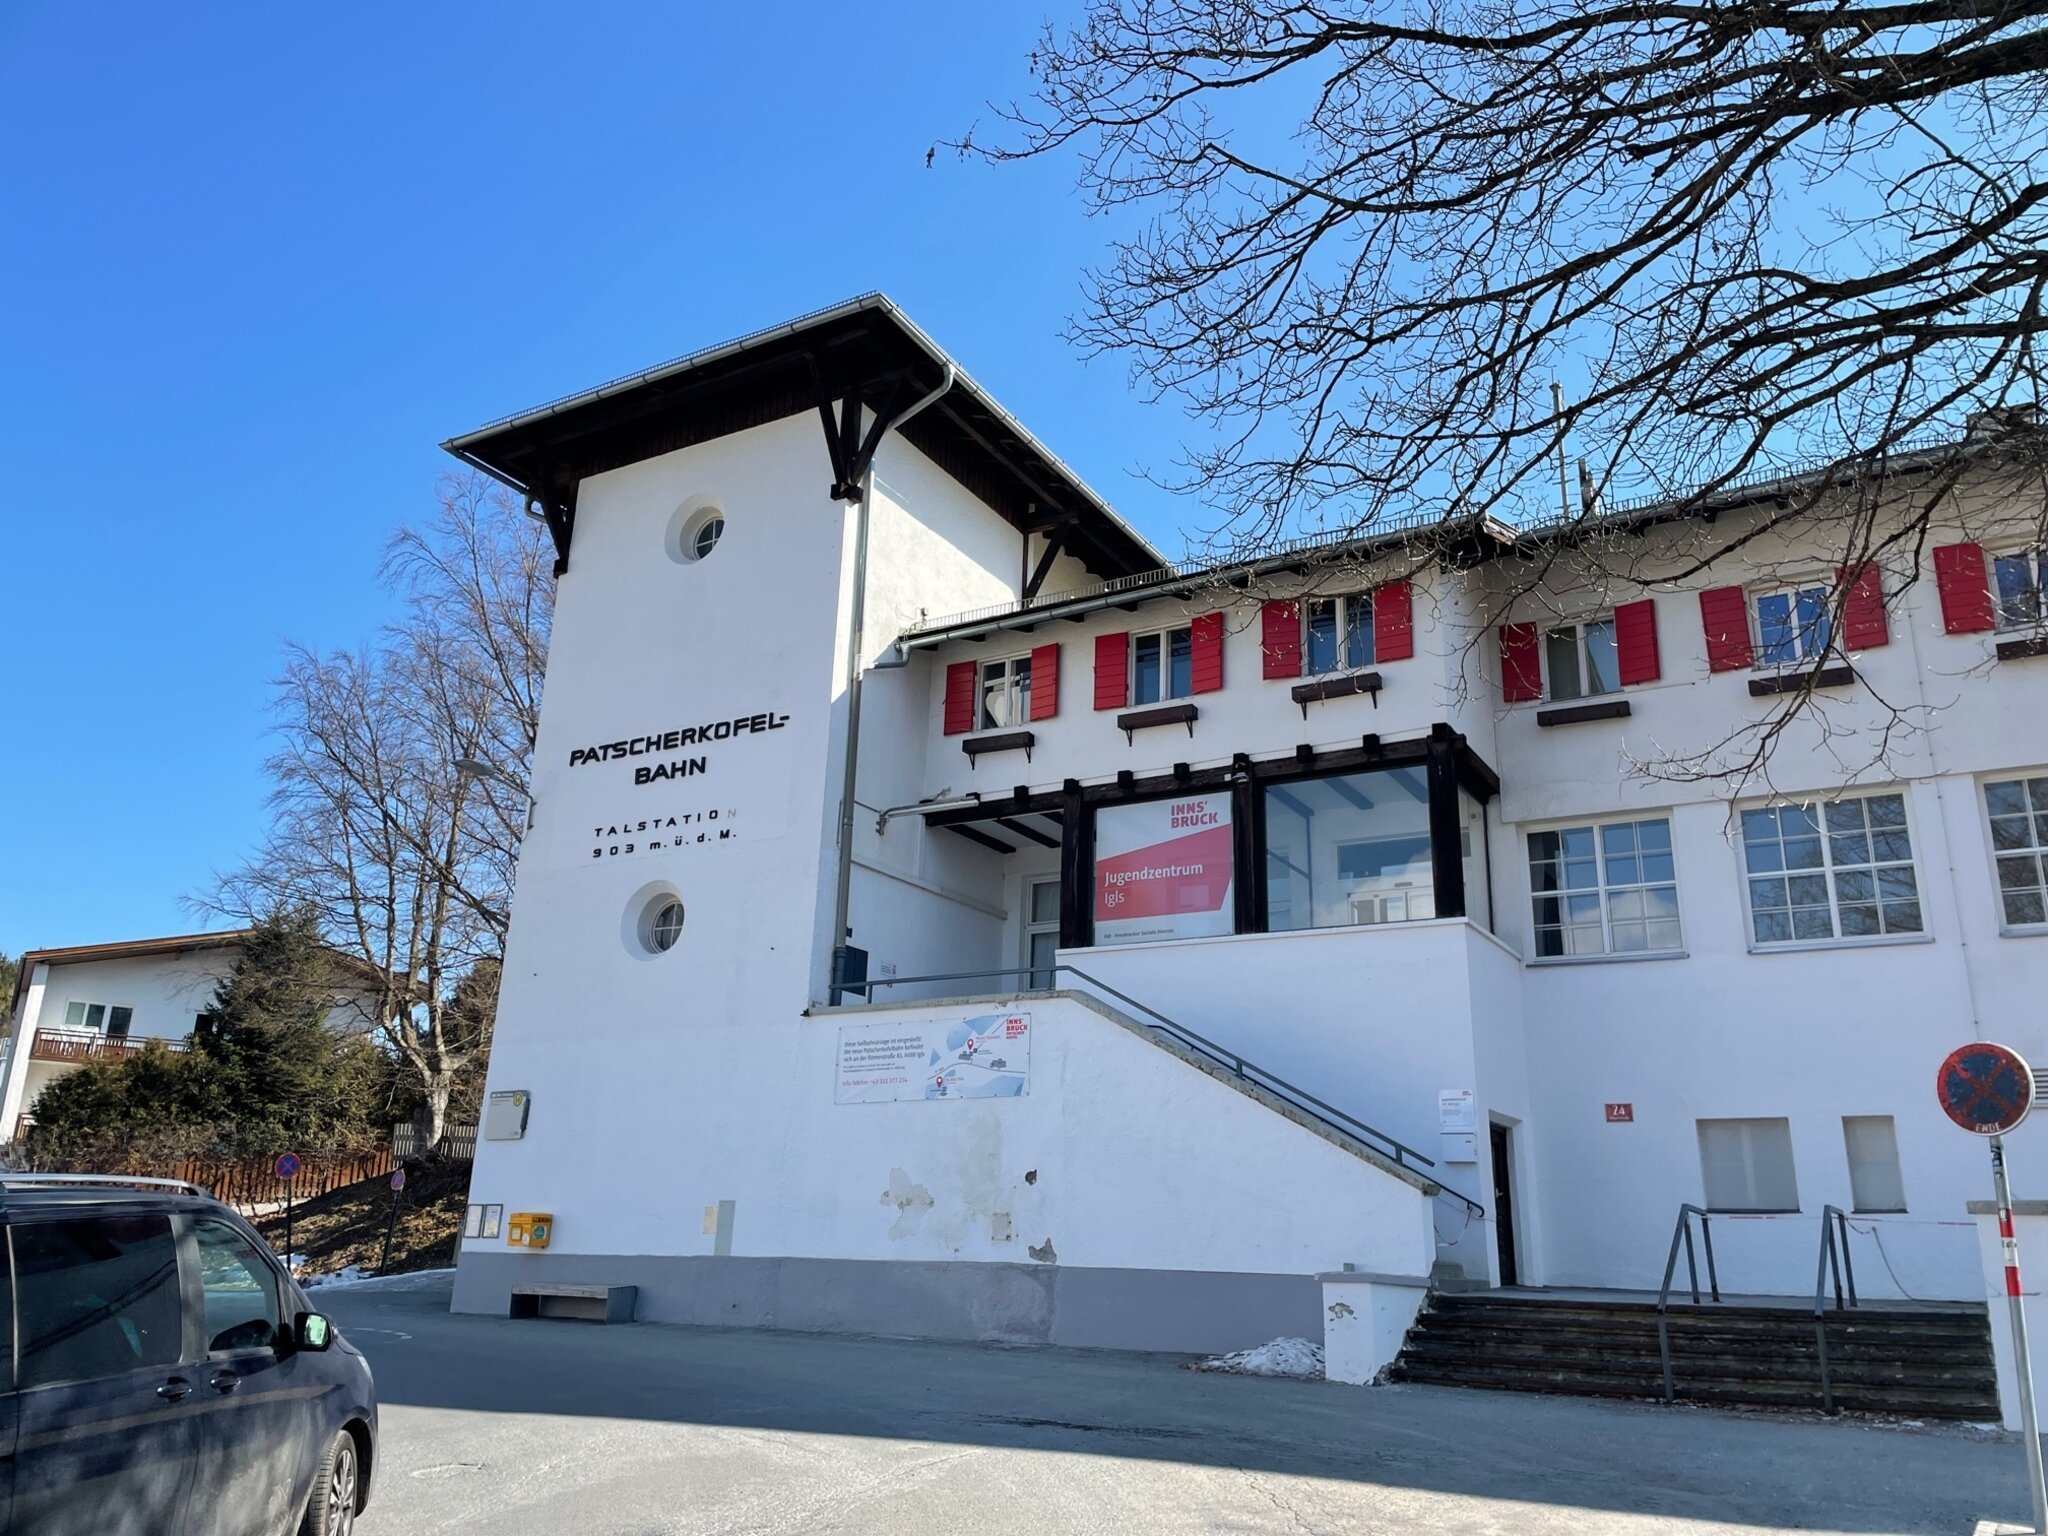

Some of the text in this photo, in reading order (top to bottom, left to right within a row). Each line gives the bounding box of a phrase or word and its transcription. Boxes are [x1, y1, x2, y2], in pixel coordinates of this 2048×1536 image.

[569, 712, 790, 767] PATSCHERKOFEL-
[634, 756, 707, 785] BAHN
[594, 808, 737, 837] TALSTATION
[1171, 812, 1218, 829] BRUCK
[592, 843, 635, 858] 903
[1104, 863, 1203, 887] Jugendzentrum
[1104, 890, 1125, 907] Igls
[1006, 1024, 1028, 1032] BRUCK
[1612, 1104, 1625, 1116] 24
